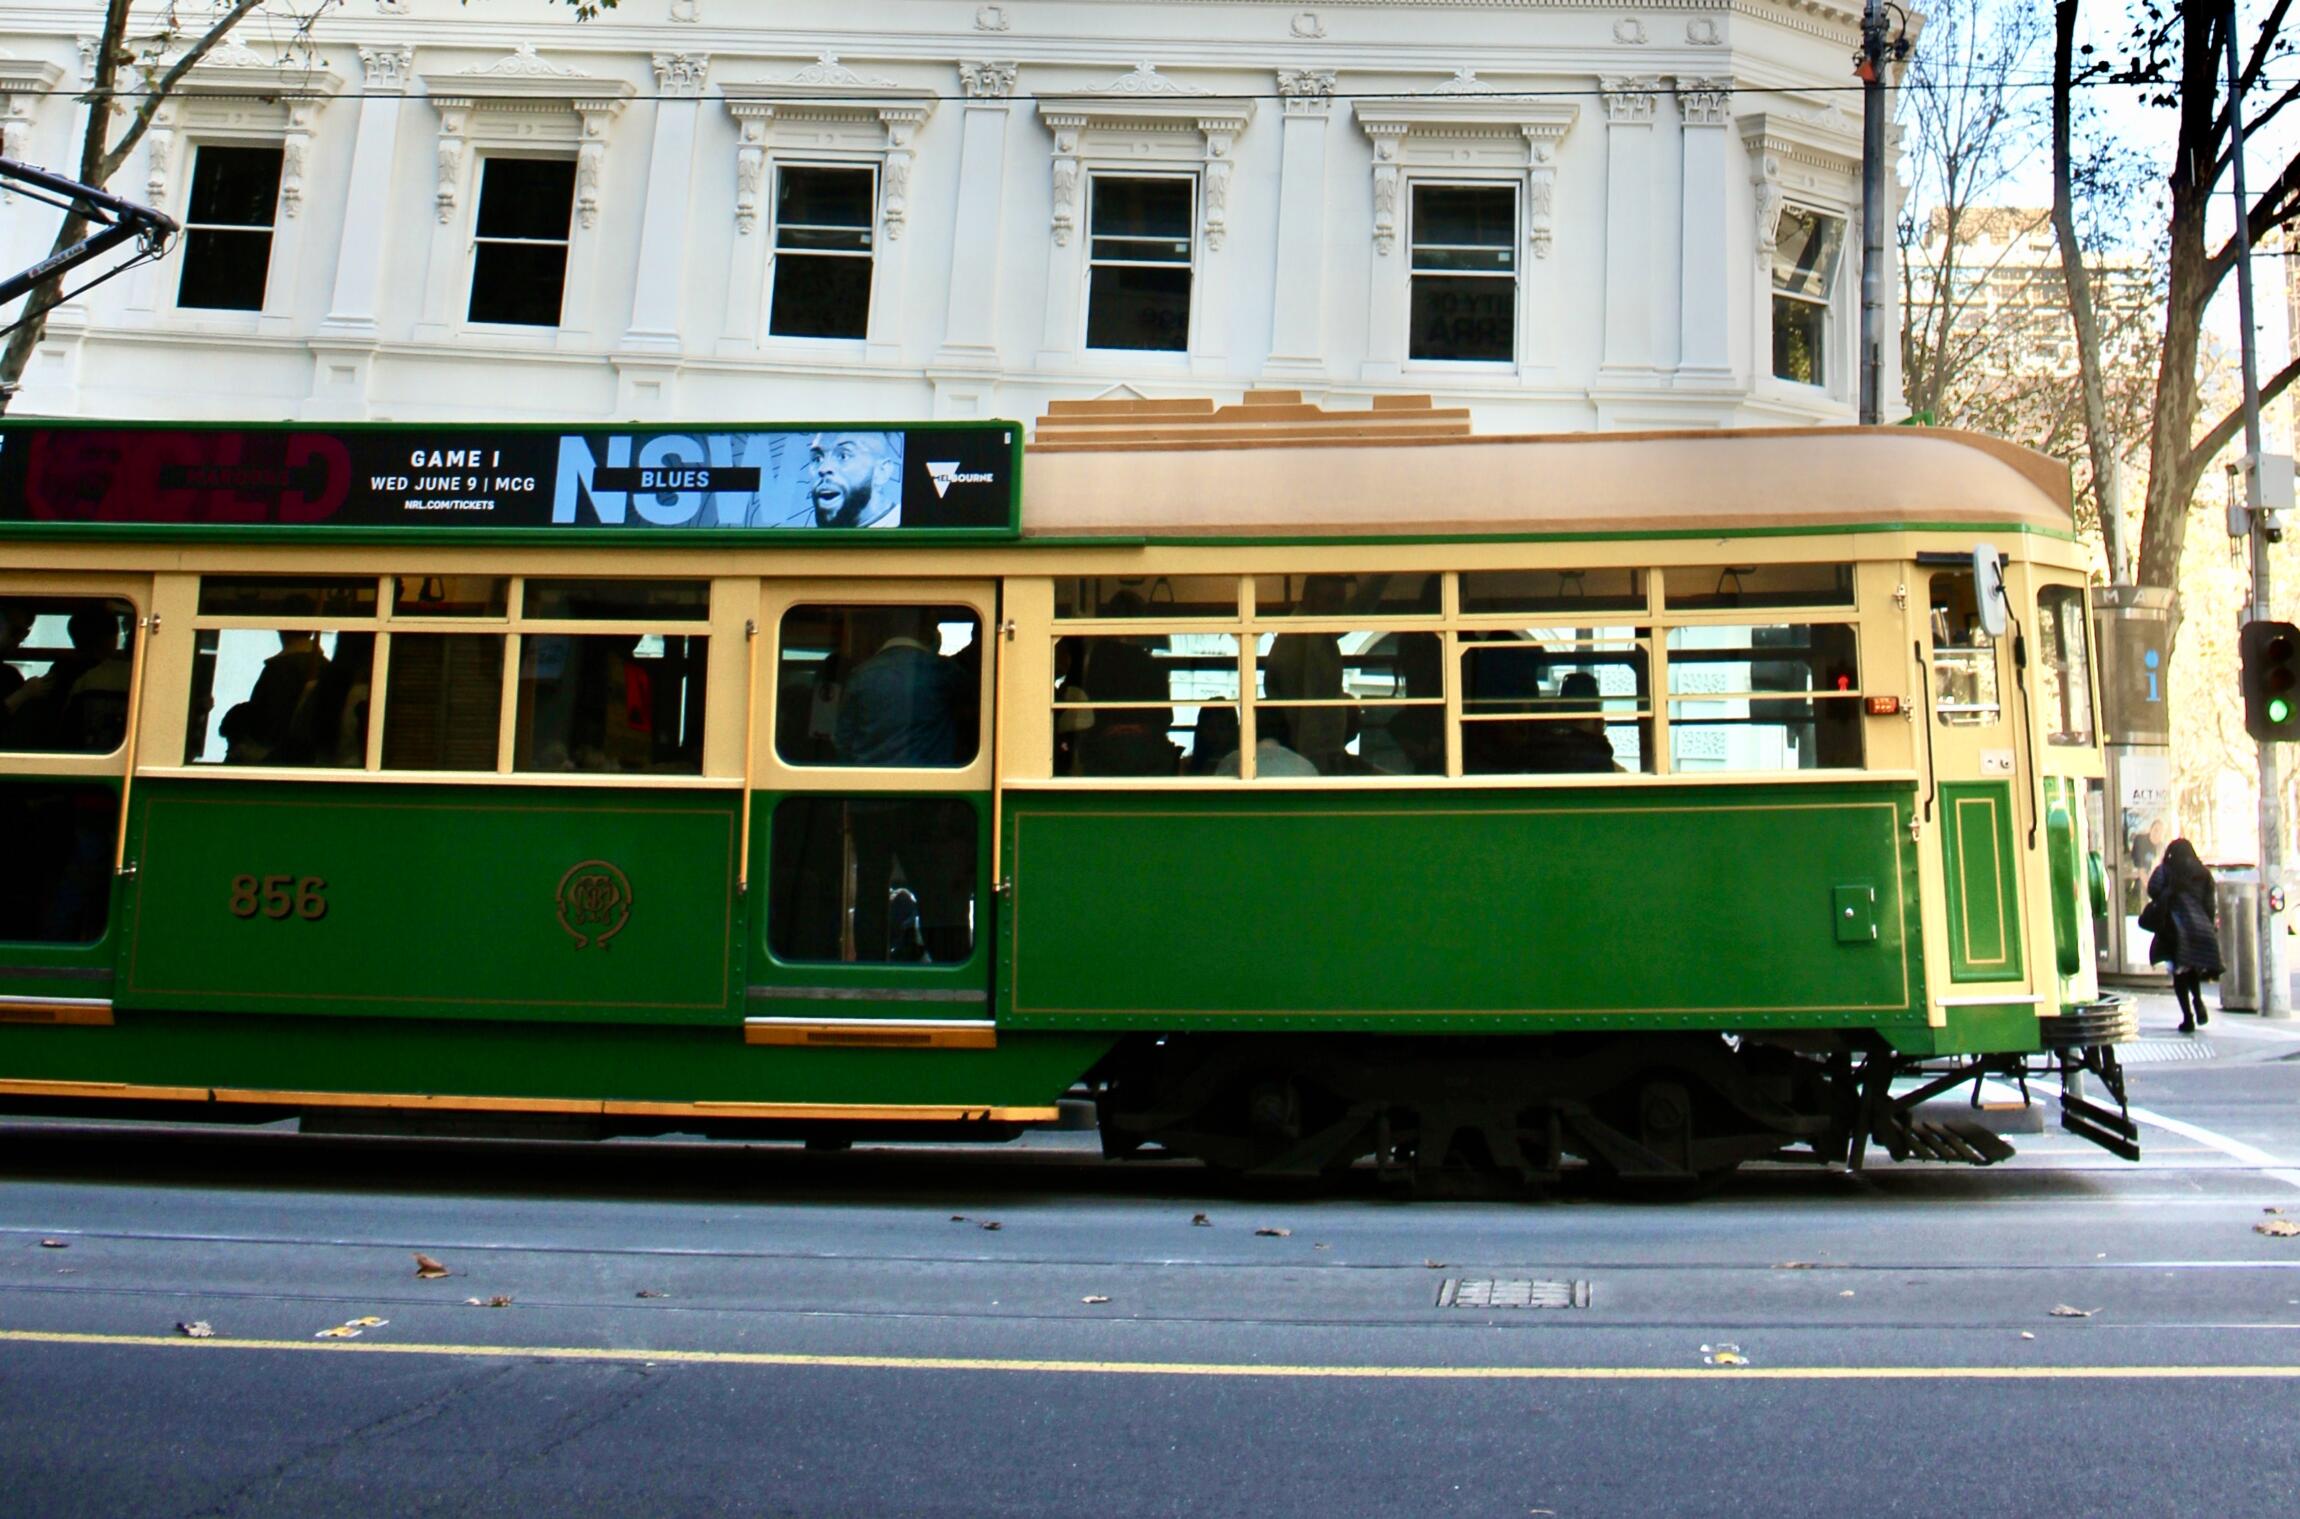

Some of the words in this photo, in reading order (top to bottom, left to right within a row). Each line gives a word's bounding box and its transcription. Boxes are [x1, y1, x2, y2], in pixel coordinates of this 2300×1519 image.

[410, 450, 482, 468] GAME
[370, 476, 409, 491] WED
[414, 476, 461, 491] JUNE
[467, 476, 478, 491] 9
[494, 476, 536, 492] MCG
[640, 470, 711, 489] BLUES
[404, 499, 495, 510] NRL.COM/TICKETS
[228, 874, 327, 919] 856
